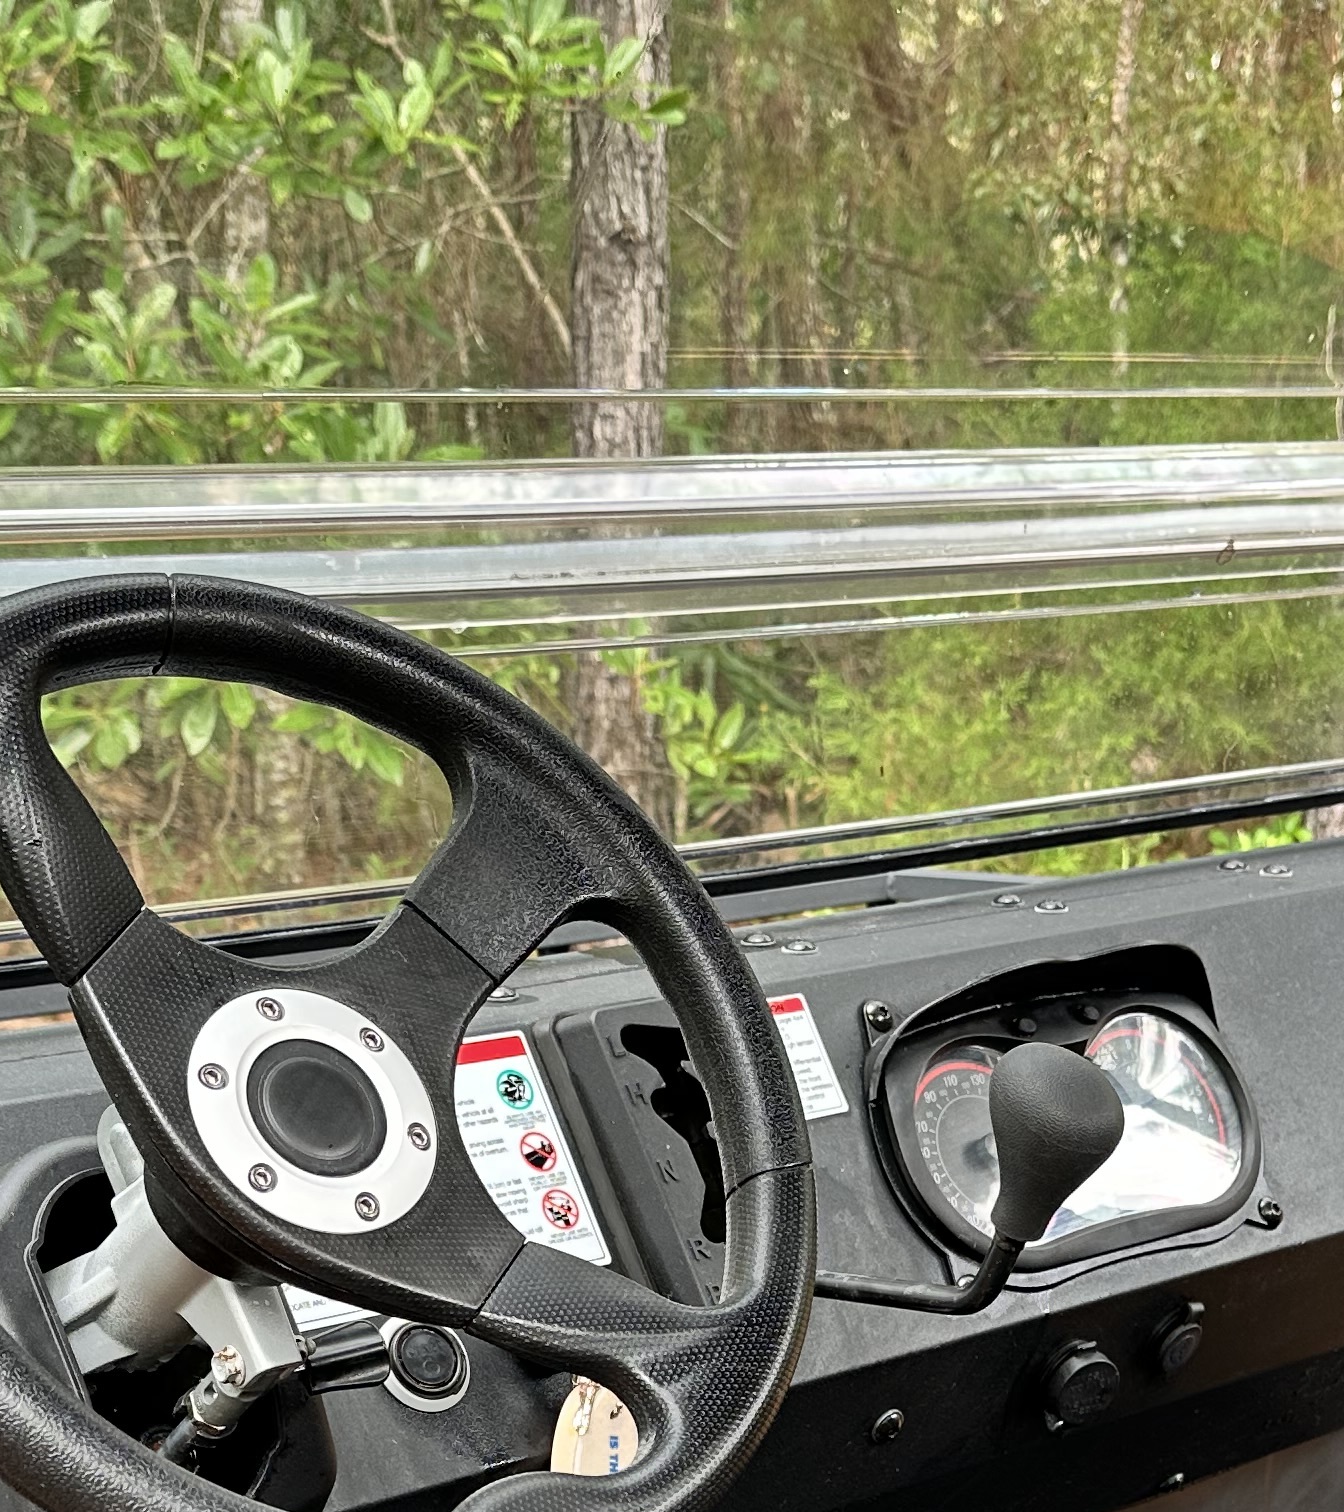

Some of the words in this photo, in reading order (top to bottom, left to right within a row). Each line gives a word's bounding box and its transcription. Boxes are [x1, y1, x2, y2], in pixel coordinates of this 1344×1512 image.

[943, 1074, 958, 1087] 110
[624, 1082, 648, 1105] H
[657, 1160, 679, 1184] N
[687, 1239, 711, 1261] R
